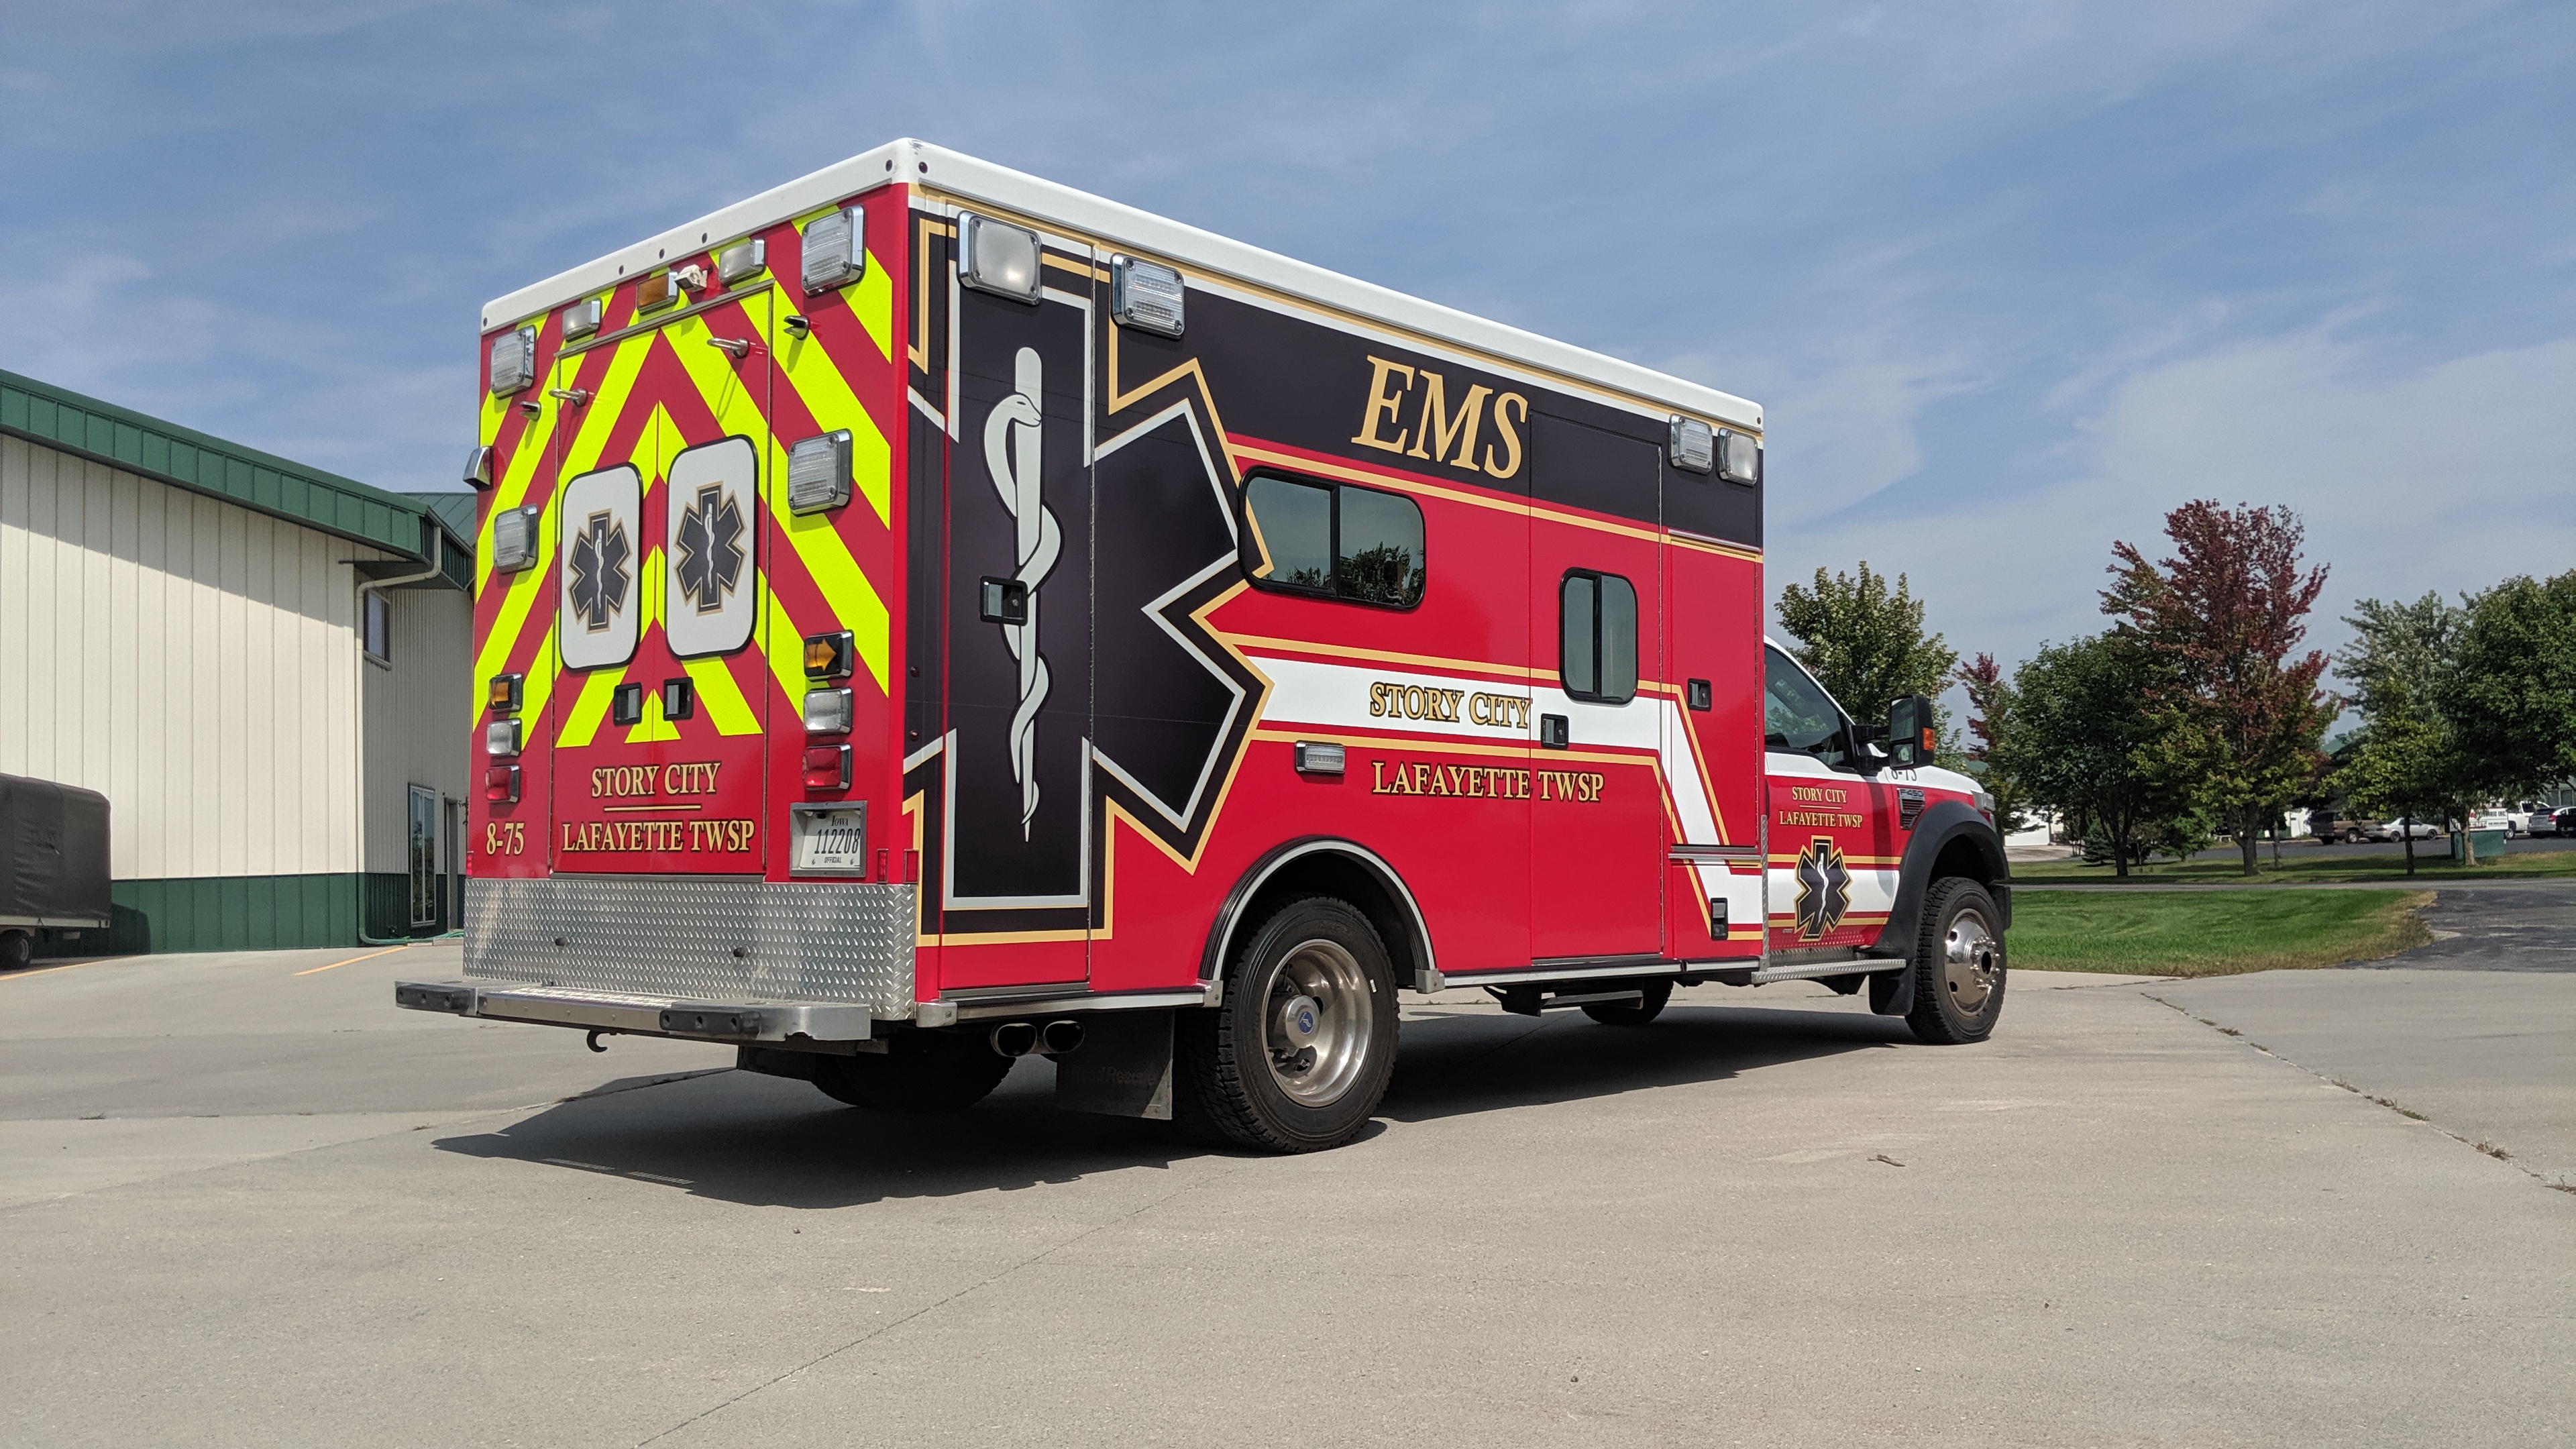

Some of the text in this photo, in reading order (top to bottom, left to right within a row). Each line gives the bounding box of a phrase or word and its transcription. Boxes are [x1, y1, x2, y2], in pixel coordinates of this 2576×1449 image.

[1350, 354, 1530, 479] EMS
[1369, 682, 1531, 729] STORY CITY
[591, 761, 721, 798] STORY CITY
[1371, 760, 1605, 802] LAFAYETTE TWSP
[1791, 786, 1847, 804] STORY CITY
[1900, 789, 1924, 797] F-450
[561, 818, 755, 853] LAFAYETTE TWSP
[1778, 810, 1864, 828] LAFAYETTE TWSP
[486, 822, 525, 855] 8-75
[814, 828, 861, 854] 112208
